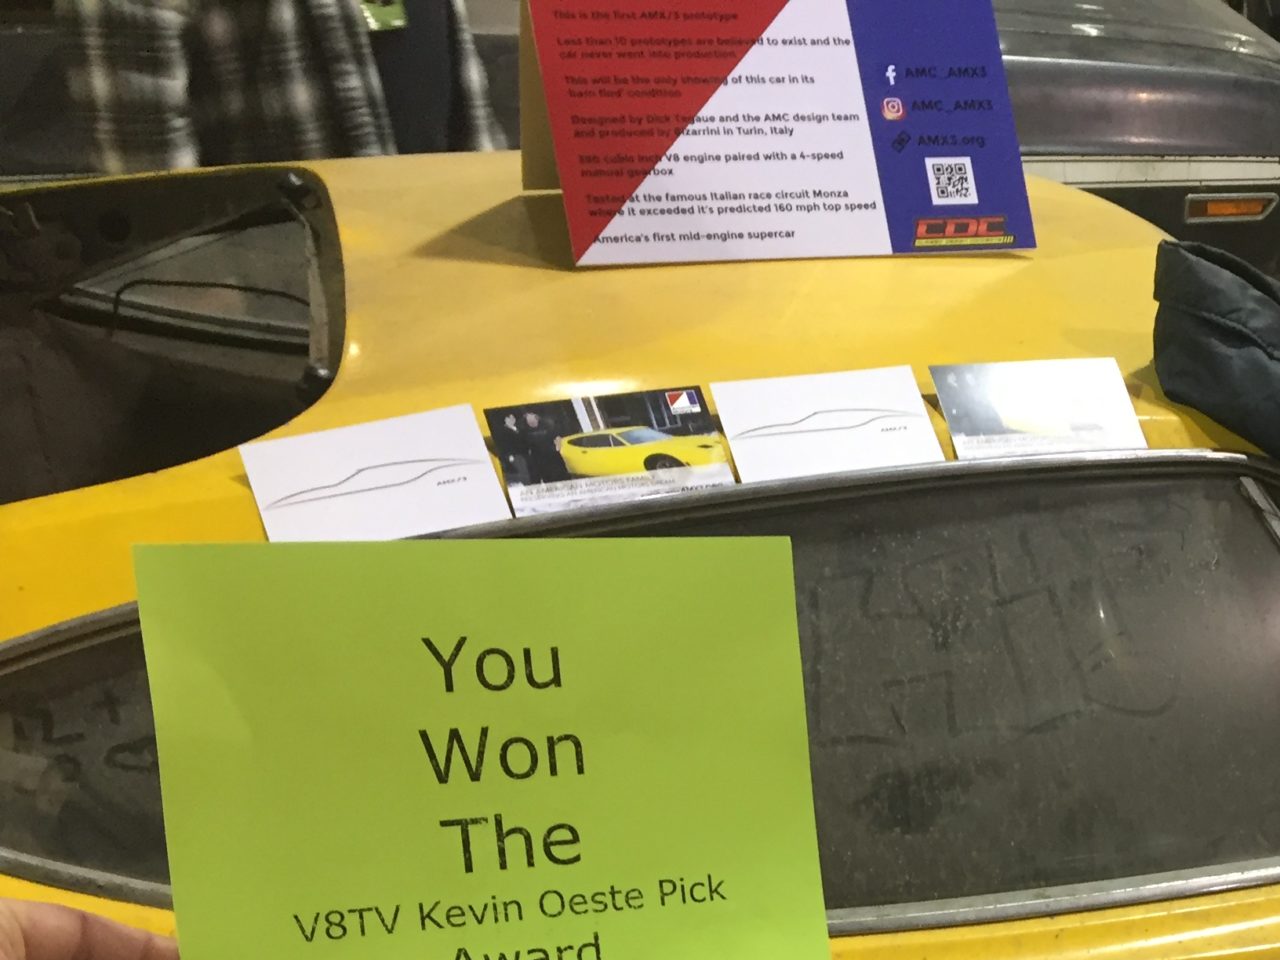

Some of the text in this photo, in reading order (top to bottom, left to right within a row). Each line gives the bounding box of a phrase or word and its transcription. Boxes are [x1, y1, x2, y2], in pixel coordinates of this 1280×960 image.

[592, 11, 609, 19] the
[767, 38, 778, 46] to
[782, 37, 807, 46] exist
[810, 37, 830, 46] and
[833, 37, 851, 46] the
[732, 75, 743, 84] of
[746, 75, 766, 84] this
[788, 75, 799, 84] in
[802, 75, 815, 84] its
[719, 114, 739, 122] and
[743, 113, 761, 122] the
[764, 113, 790, 122] AMC
[793, 112, 829, 123] design
[832, 113, 860, 121] team
[723, 126, 734, 135] in
[736, 126, 767, 136] Turin,
[770, 126, 794, 137] Italy
[665, 153, 680, 162] V8
[683, 153, 721, 164] engine
[724, 152, 760, 163] paired
[762, 152, 788, 161] with
[800, 151, 844, 162] 4-speed
[630, 194, 641, 203] at
[643, 193, 662, 202] the
[666, 193, 707, 201] famous
[710, 192, 746, 200] Italian
[775, 190, 810, 199] circuit
[812, 190, 849, 198] Monza
[628, 207, 637, 216] it
[639, 206, 695, 216] exceeded
[698, 205, 714, 214] it's
[717, 204, 772, 215] predicted
[774, 203, 793, 212] 160
[796, 203, 821, 214] mph
[823, 203, 842, 213] top
[844, 202, 877, 212] speed
[916, 217, 1004, 237] CDC
[594, 231, 796, 244] America's first mid-engine supercar
[421, 636, 563, 692] You
[418, 726, 586, 785] Won
[439, 814, 582, 874] The
[293, 874, 727, 943] V8TV Kevin Oeste Pick
